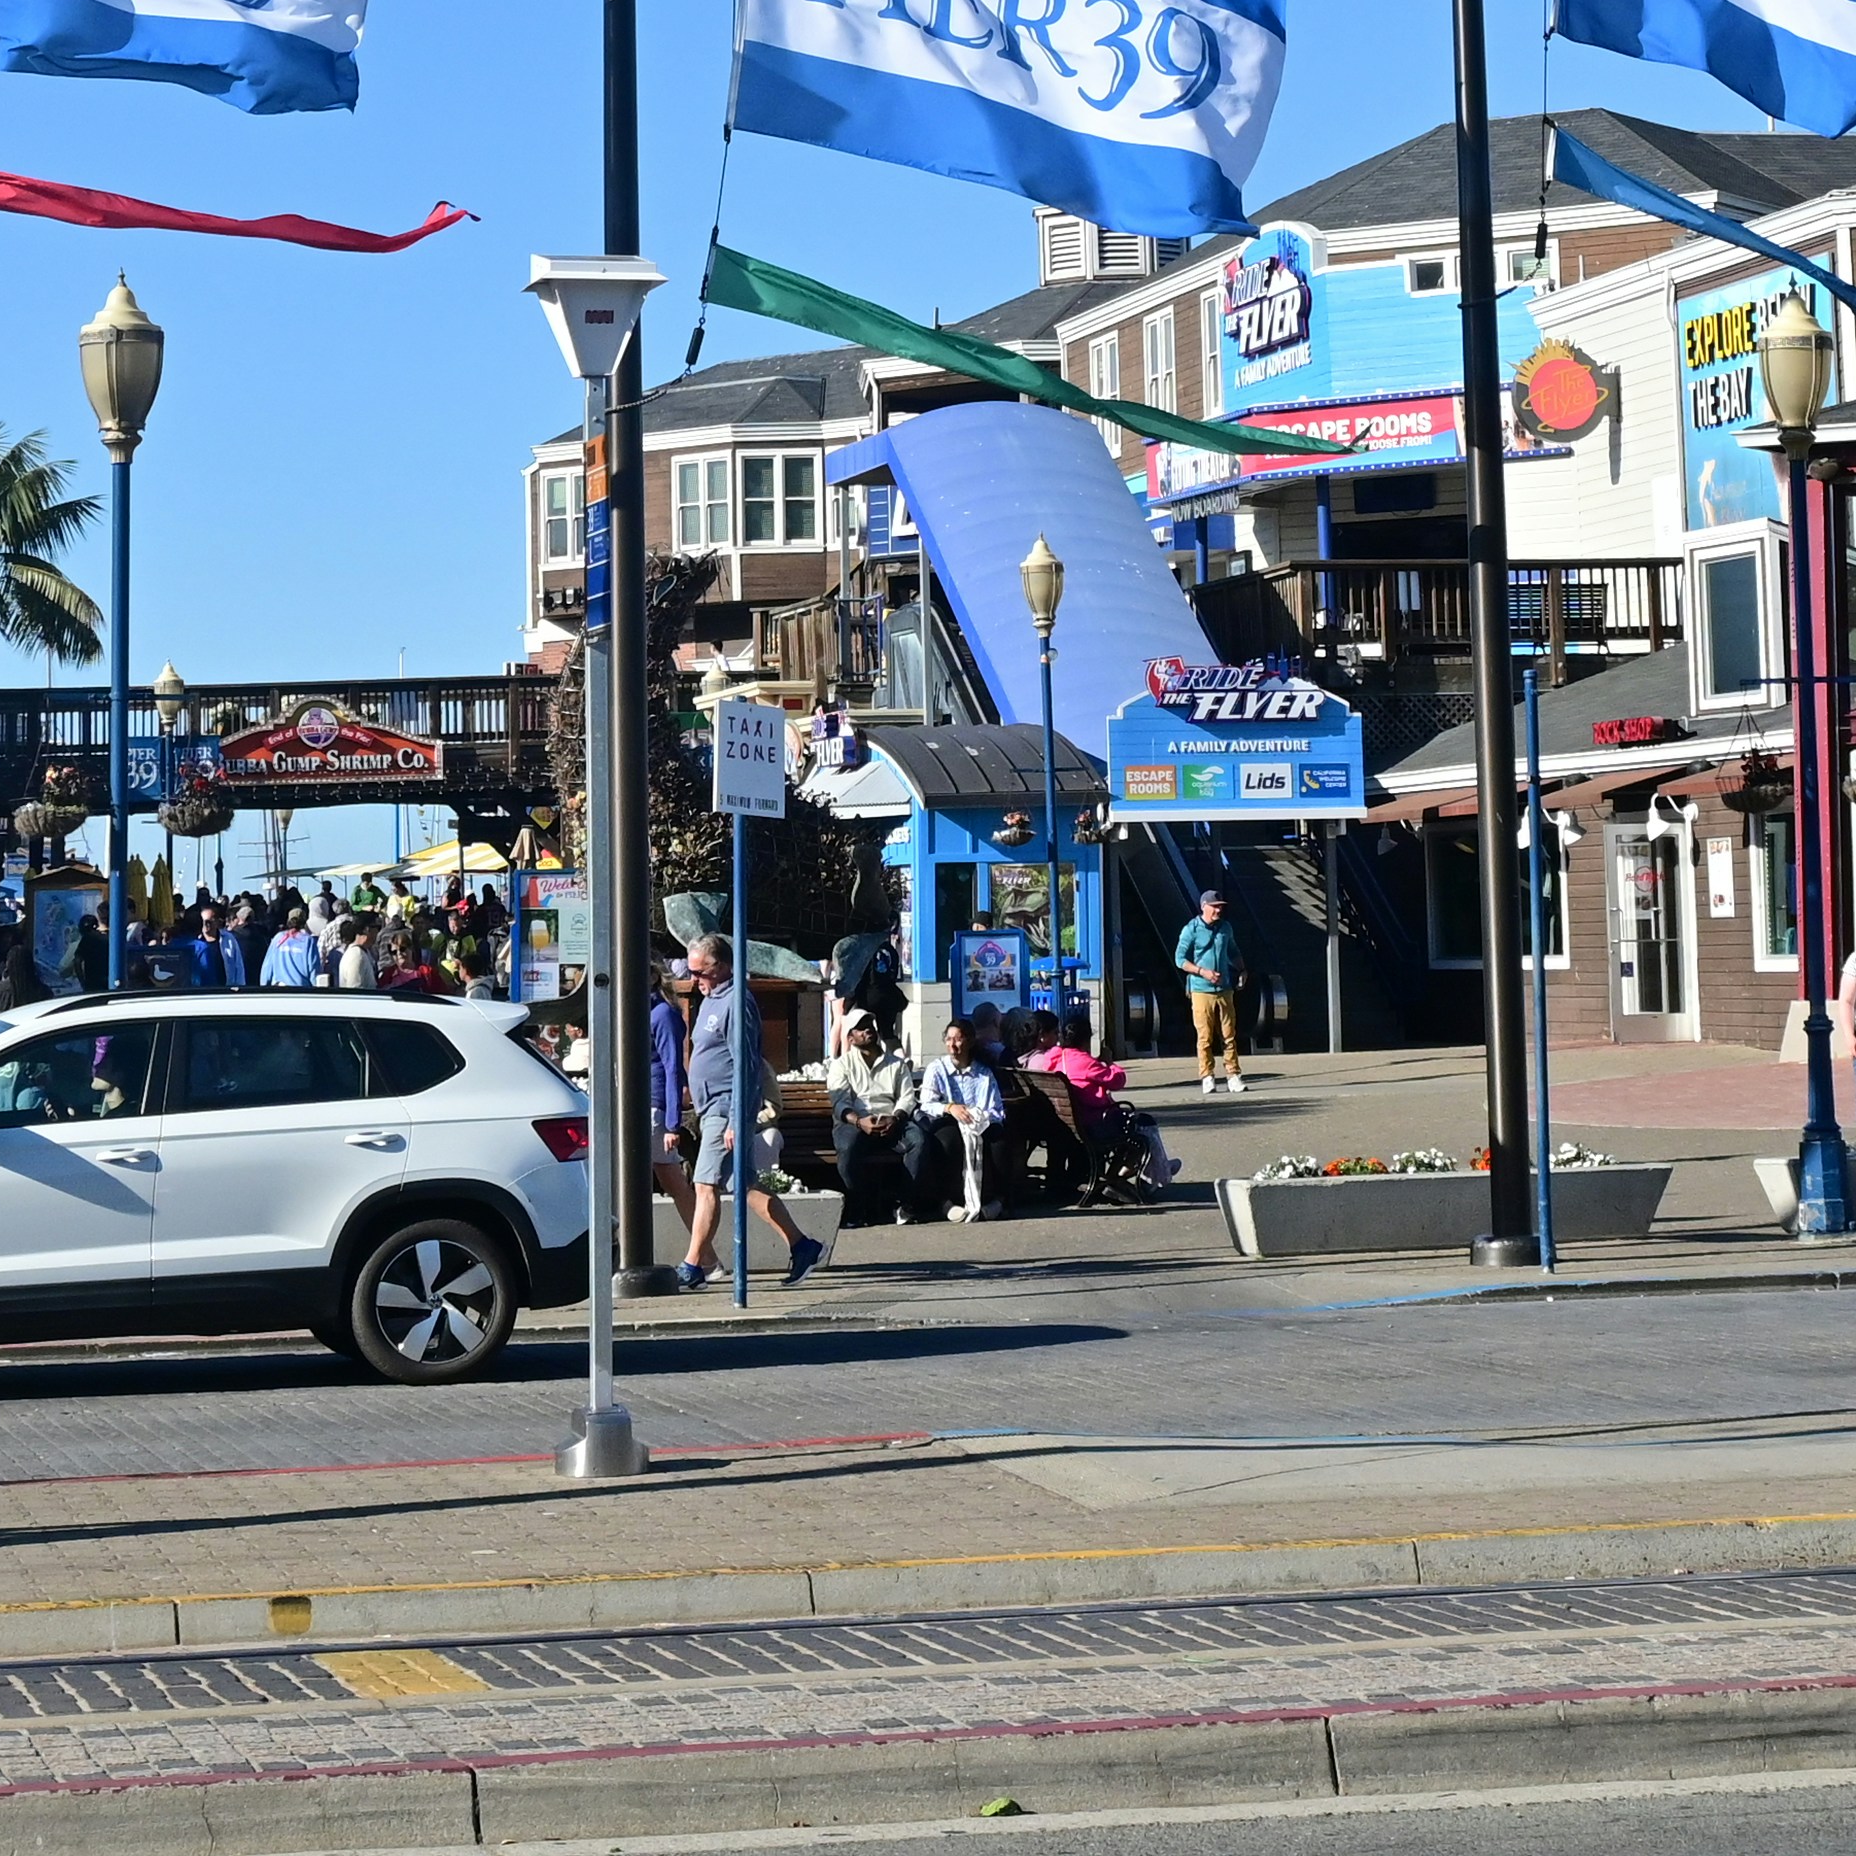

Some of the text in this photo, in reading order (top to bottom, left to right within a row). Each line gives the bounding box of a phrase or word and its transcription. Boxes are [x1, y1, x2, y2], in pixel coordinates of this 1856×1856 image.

[1231, 257, 1271, 309] RIDE
[1224, 288, 1302, 355] THE FLYER
[1684, 301, 1755, 369] EXPLORE
[1234, 342, 1312, 390] A FAMILY ADVENTURE
[1552, 368, 1585, 394] The
[1538, 388, 1592, 420] Flyer
[1687, 366, 1750, 430] THE BAY
[1355, 410, 1433, 443] ROOMS
[1172, 490, 1240, 523] NOW BOARDING
[1180, 665, 1265, 691] RIDE
[1160, 690, 1326, 721] THE FLYER
[727, 716, 774, 740] TAXI
[1624, 716, 1655, 742] SHOP
[726, 740, 777, 764] ZONE
[1167, 738, 1311, 754] A FAMILY ADVENTURE
[127, 760, 158, 790] 39
[272, 750, 322, 773] GUMP
[326, 749, 392, 772] SHRIMP
[1125, 769, 1174, 783] ESCAPE
[1129, 782, 1171, 795] ROOMS
[1244, 772, 1287, 791] Lids
